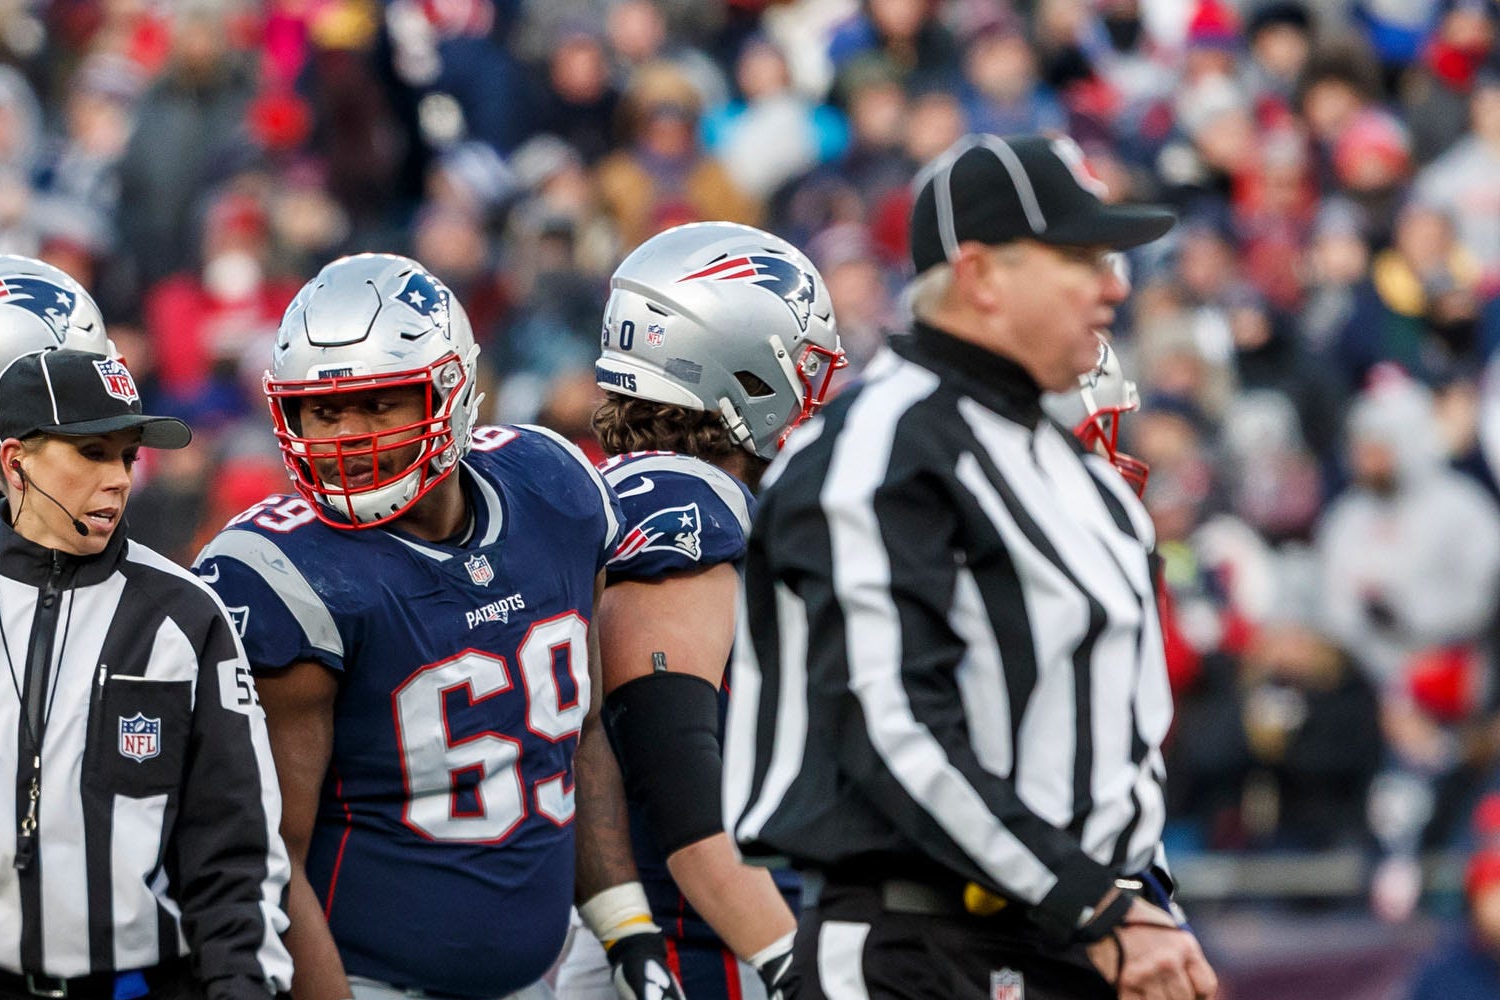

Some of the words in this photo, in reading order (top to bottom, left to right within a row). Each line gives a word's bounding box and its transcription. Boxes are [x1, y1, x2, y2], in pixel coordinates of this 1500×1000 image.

[106, 375, 136, 398] NFL
[465, 593, 526, 630] PATRIOTS
[391, 609, 591, 844] 69
[124, 735, 156, 755] NFL
